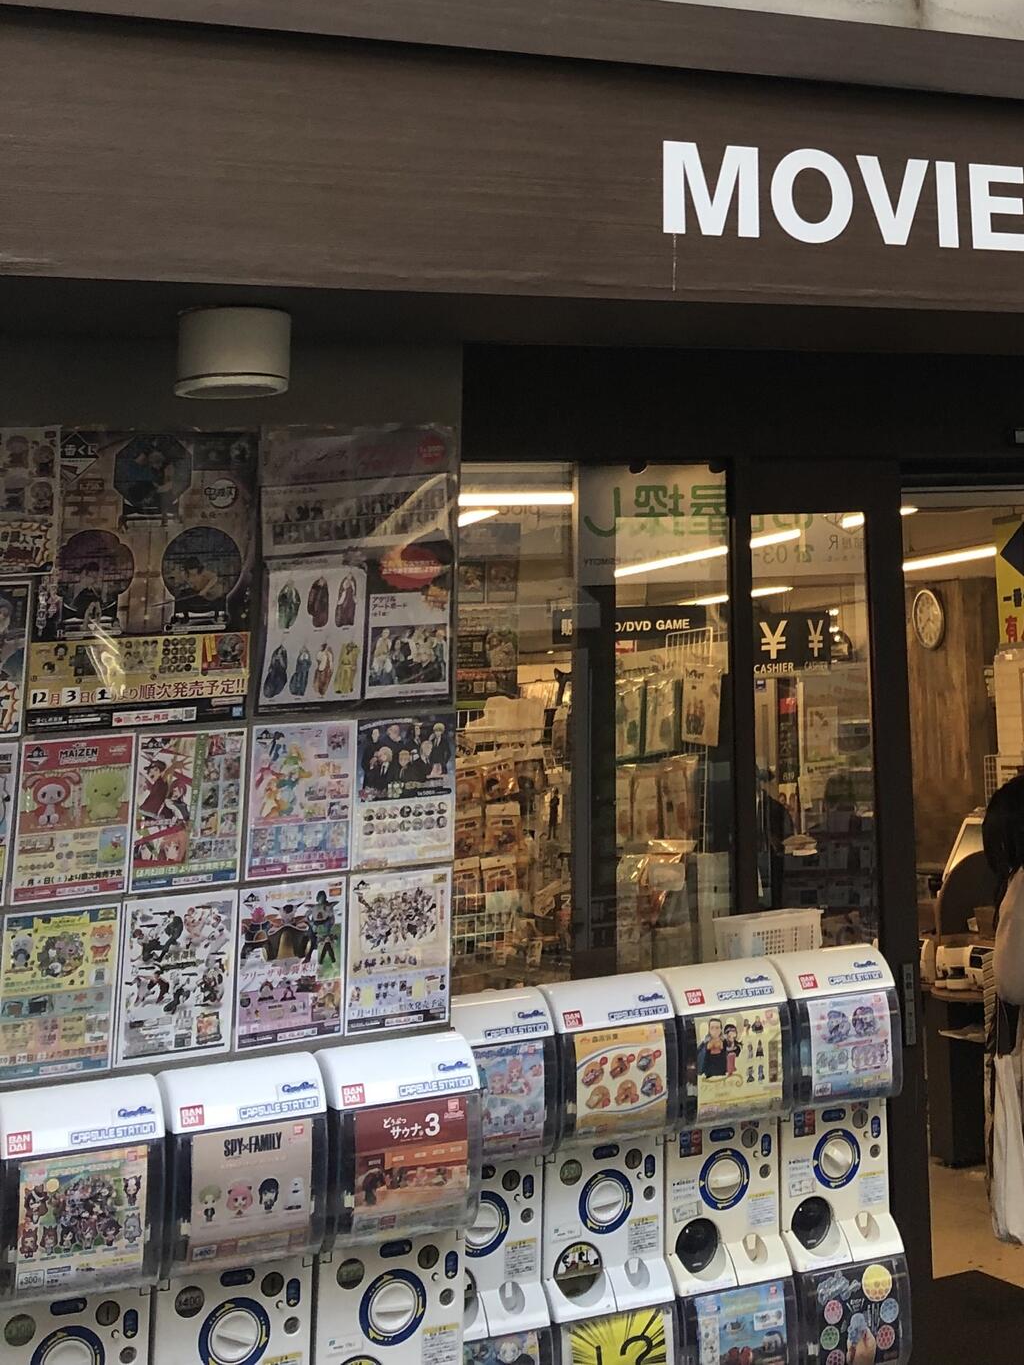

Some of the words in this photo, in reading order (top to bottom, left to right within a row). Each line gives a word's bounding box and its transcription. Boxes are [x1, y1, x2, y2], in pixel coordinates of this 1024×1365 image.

[656, 617, 690, 631] GAME
[753, 661, 795, 674] CASHIER
[342, 1086, 364, 1096] BAN
[180, 1106, 203, 1117] BAN
[390, 1122, 422, 1140] サウナ
[424, 1112, 441, 1137] 3
[8, 1133, 31, 1143] BAN
